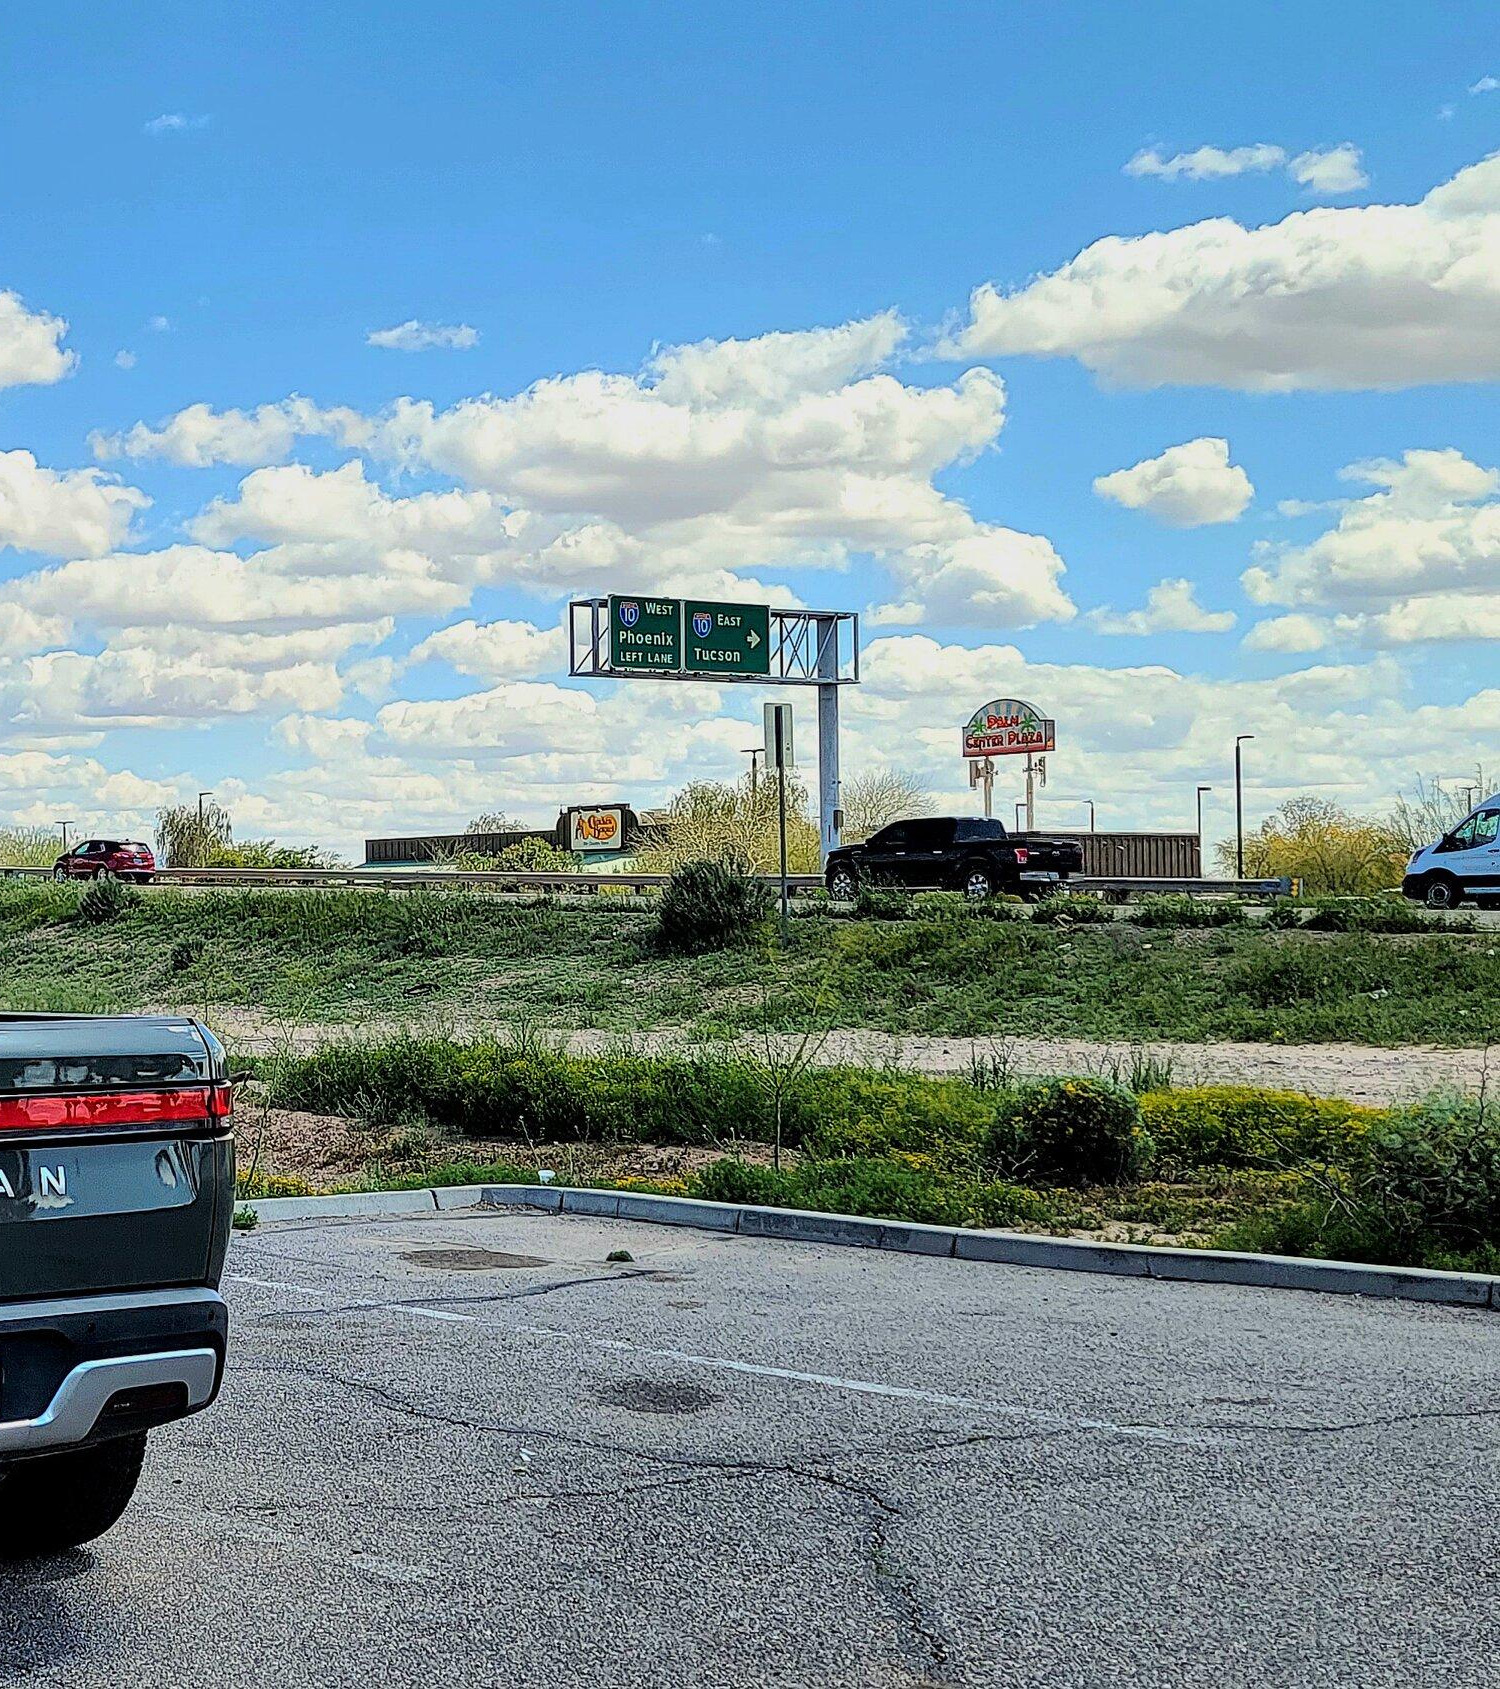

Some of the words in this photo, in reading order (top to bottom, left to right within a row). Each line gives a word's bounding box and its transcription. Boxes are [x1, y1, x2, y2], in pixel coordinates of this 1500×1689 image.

[624, 608, 636, 622] 10
[645, 601, 673, 616] WEST
[697, 619, 708, 633] 10
[717, 613, 741, 627] EAST
[619, 631, 673, 647] Phoenix
[620, 650, 642, 663] LEFT
[647, 652, 673, 664] LANE
[694, 647, 740, 662] Tucson
